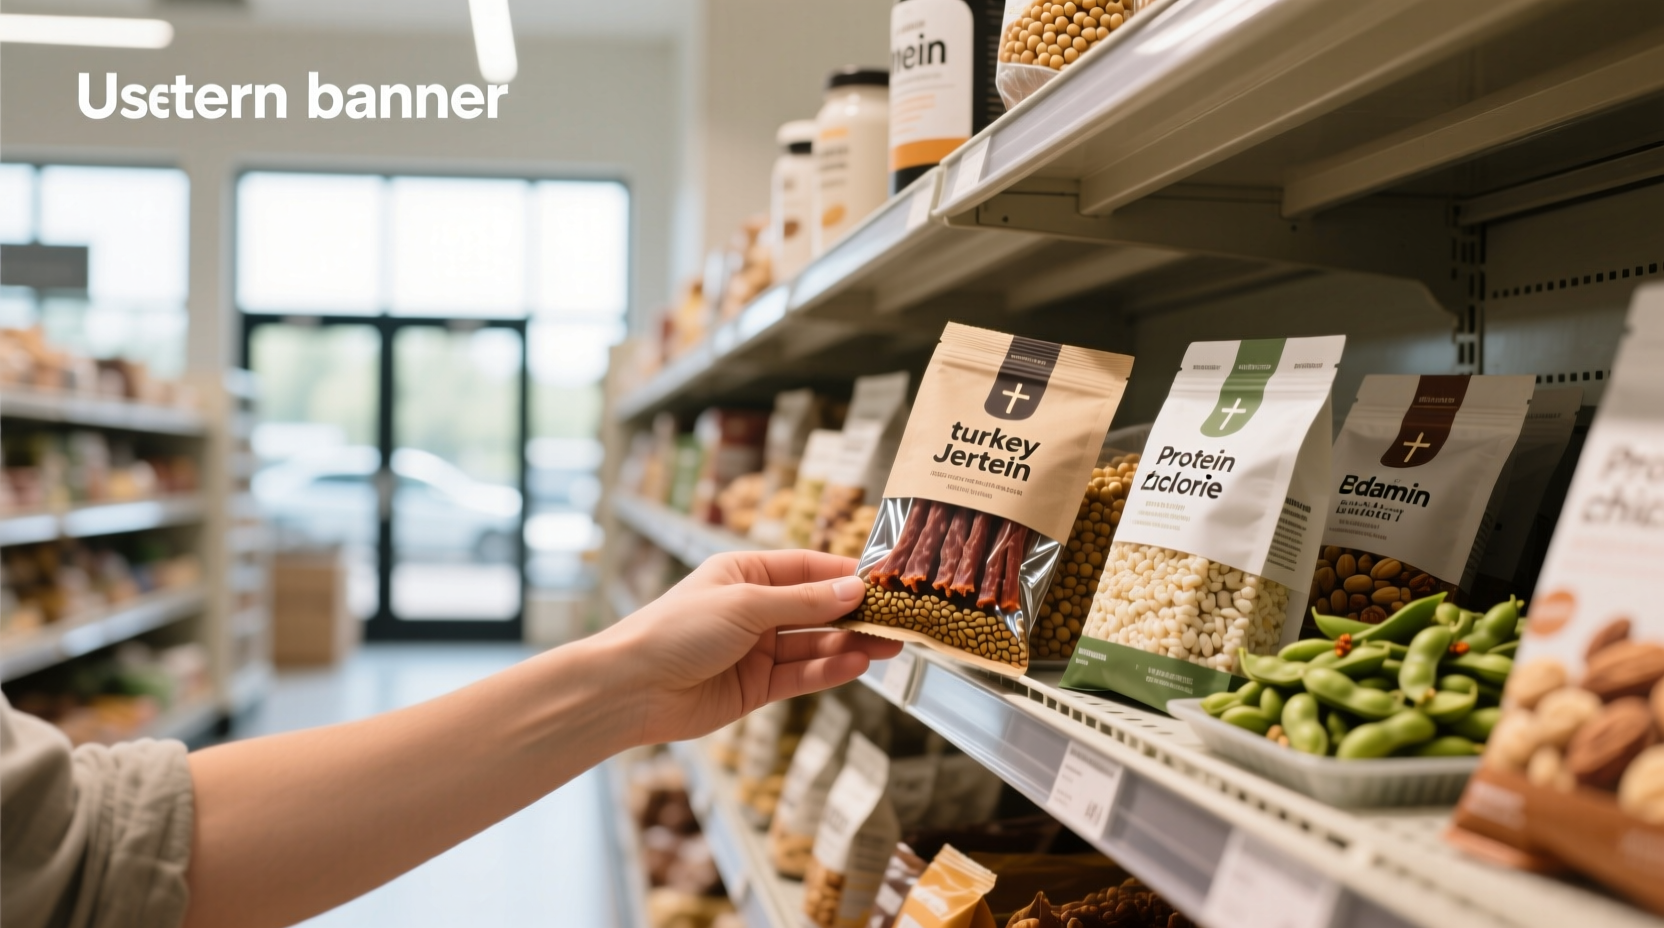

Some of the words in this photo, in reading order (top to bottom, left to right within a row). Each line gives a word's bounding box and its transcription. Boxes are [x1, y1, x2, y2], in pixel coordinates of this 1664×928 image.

[951, 421, 1041, 461] turkey
[1156, 446, 1236, 473] Protein
[933, 443, 1031, 482] Jertein
